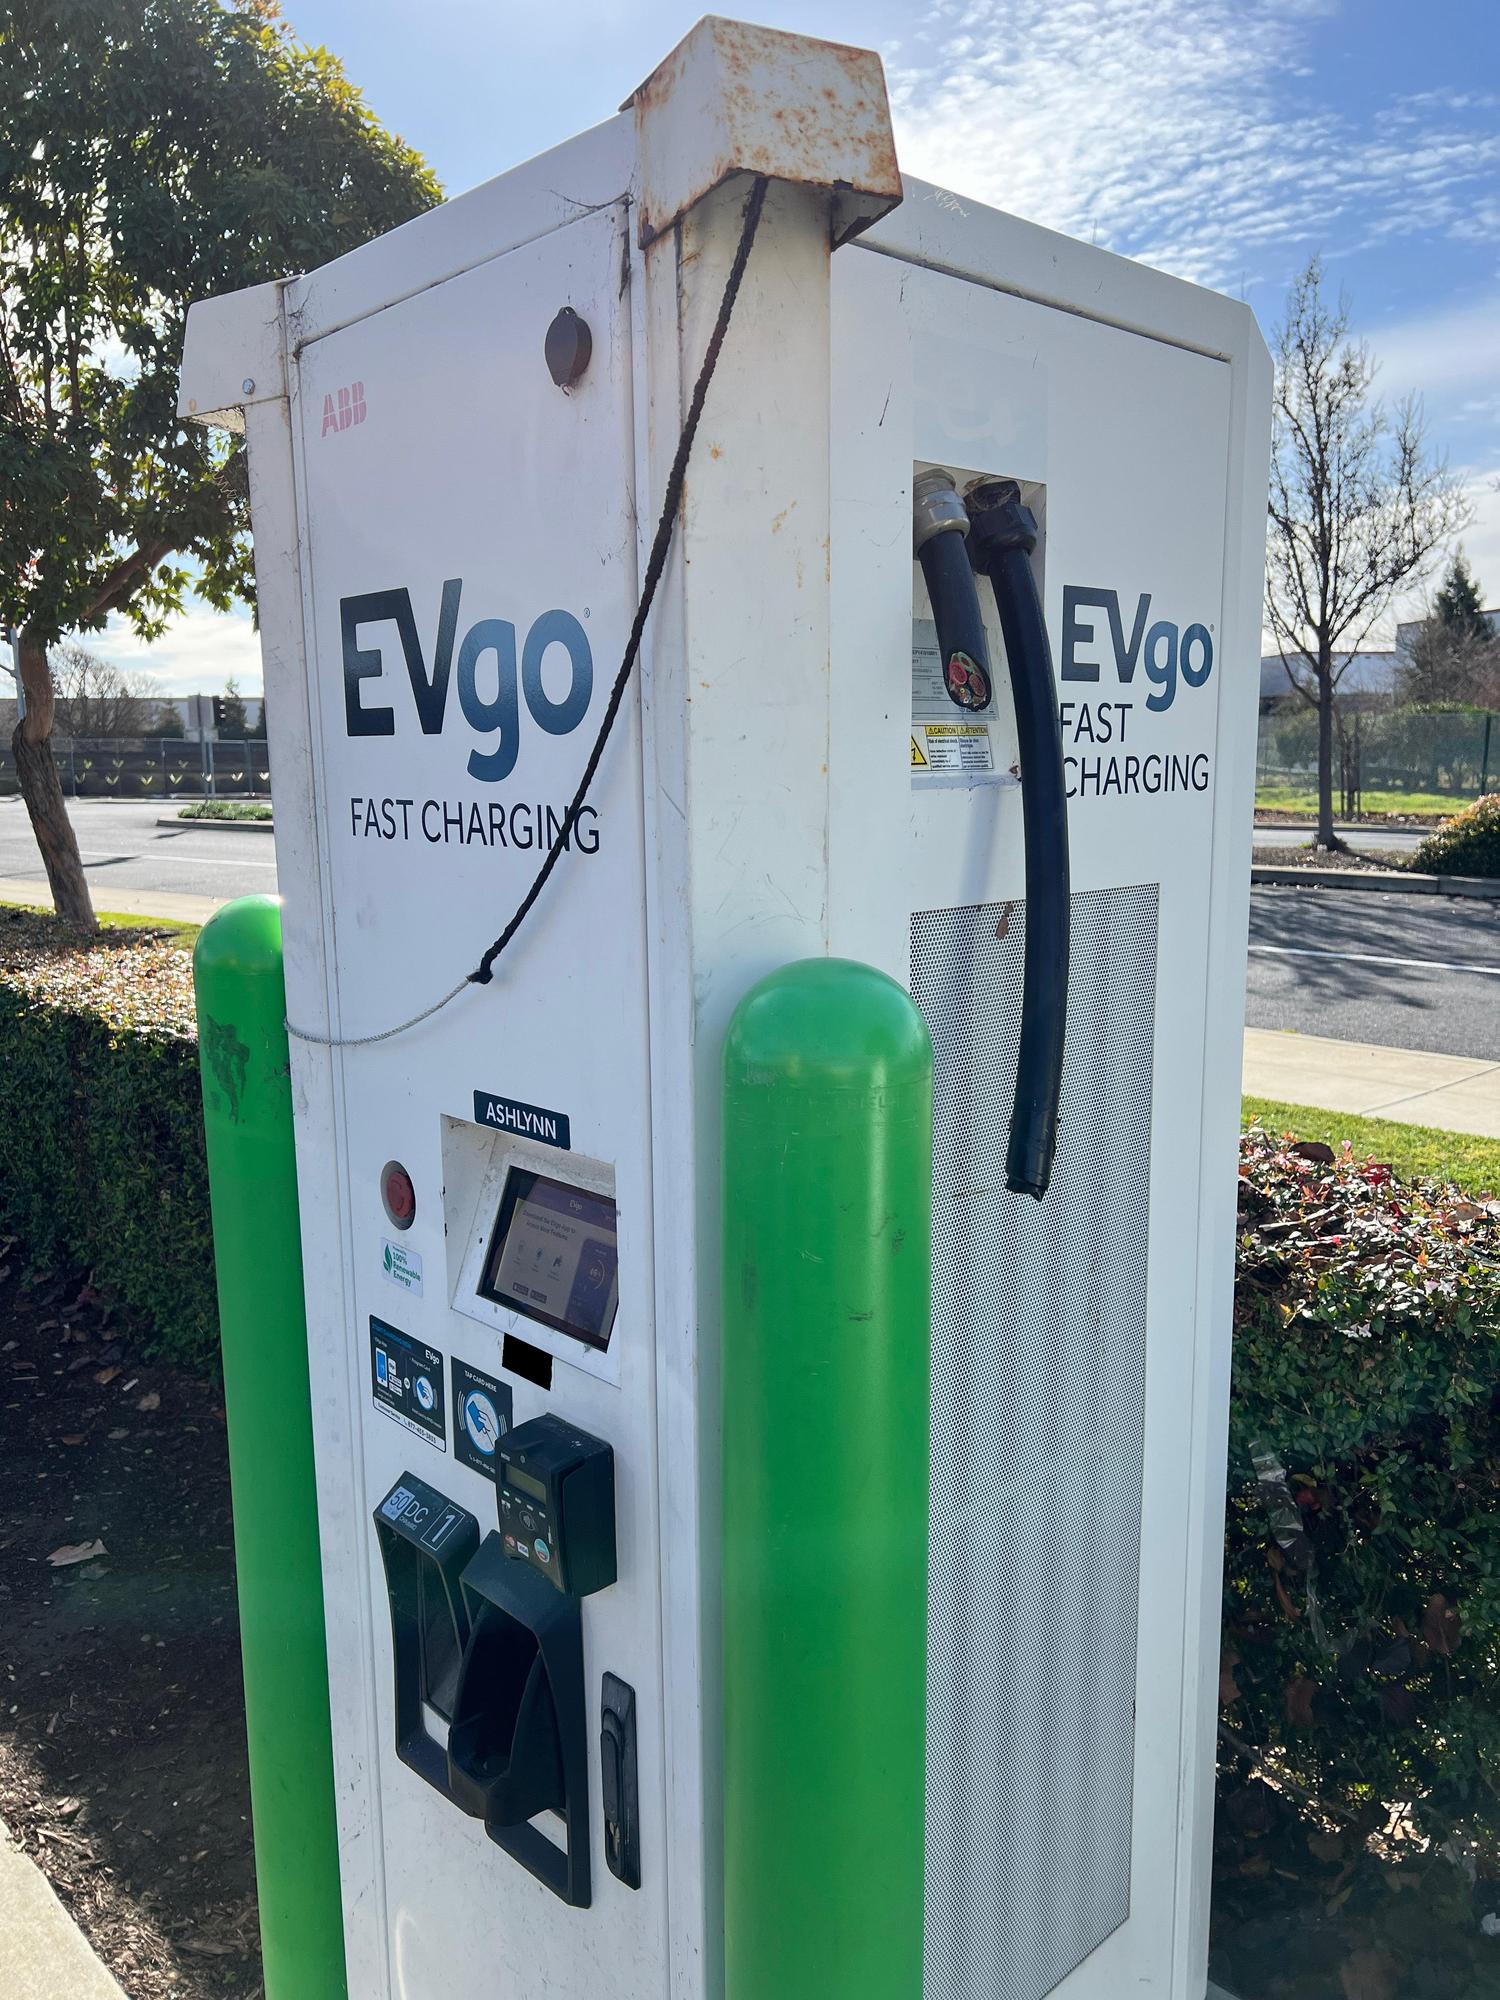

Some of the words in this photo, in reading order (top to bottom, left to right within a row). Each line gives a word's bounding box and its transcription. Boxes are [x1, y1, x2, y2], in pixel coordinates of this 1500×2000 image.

[321, 381, 367, 437] ABB
[1061, 584, 1214, 712] EVgo
[933, 727, 957, 735] CAUTION
[1060, 702, 1133, 743] FAST
[1063, 753, 1209, 798] CHARGING
[351, 798, 414, 840] FAST
[422, 800, 600, 854] CHARGING
[486, 1101, 557, 1140] ASHLYNN
[393, 1252, 407, 1265] 100%
[393, 1260, 421, 1281] Renewable
[394, 1270, 411, 1287] Energy
[425, 1349, 440, 1365] EVgo
[464, 1370, 473, 1379] TAP
[472, 1374, 485, 1386] CARD
[485, 1381, 497, 1392] HERE
[390, 1491, 410, 1511] 50
[403, 1500, 429, 1523] DC
[431, 1514, 456, 1543] 1
